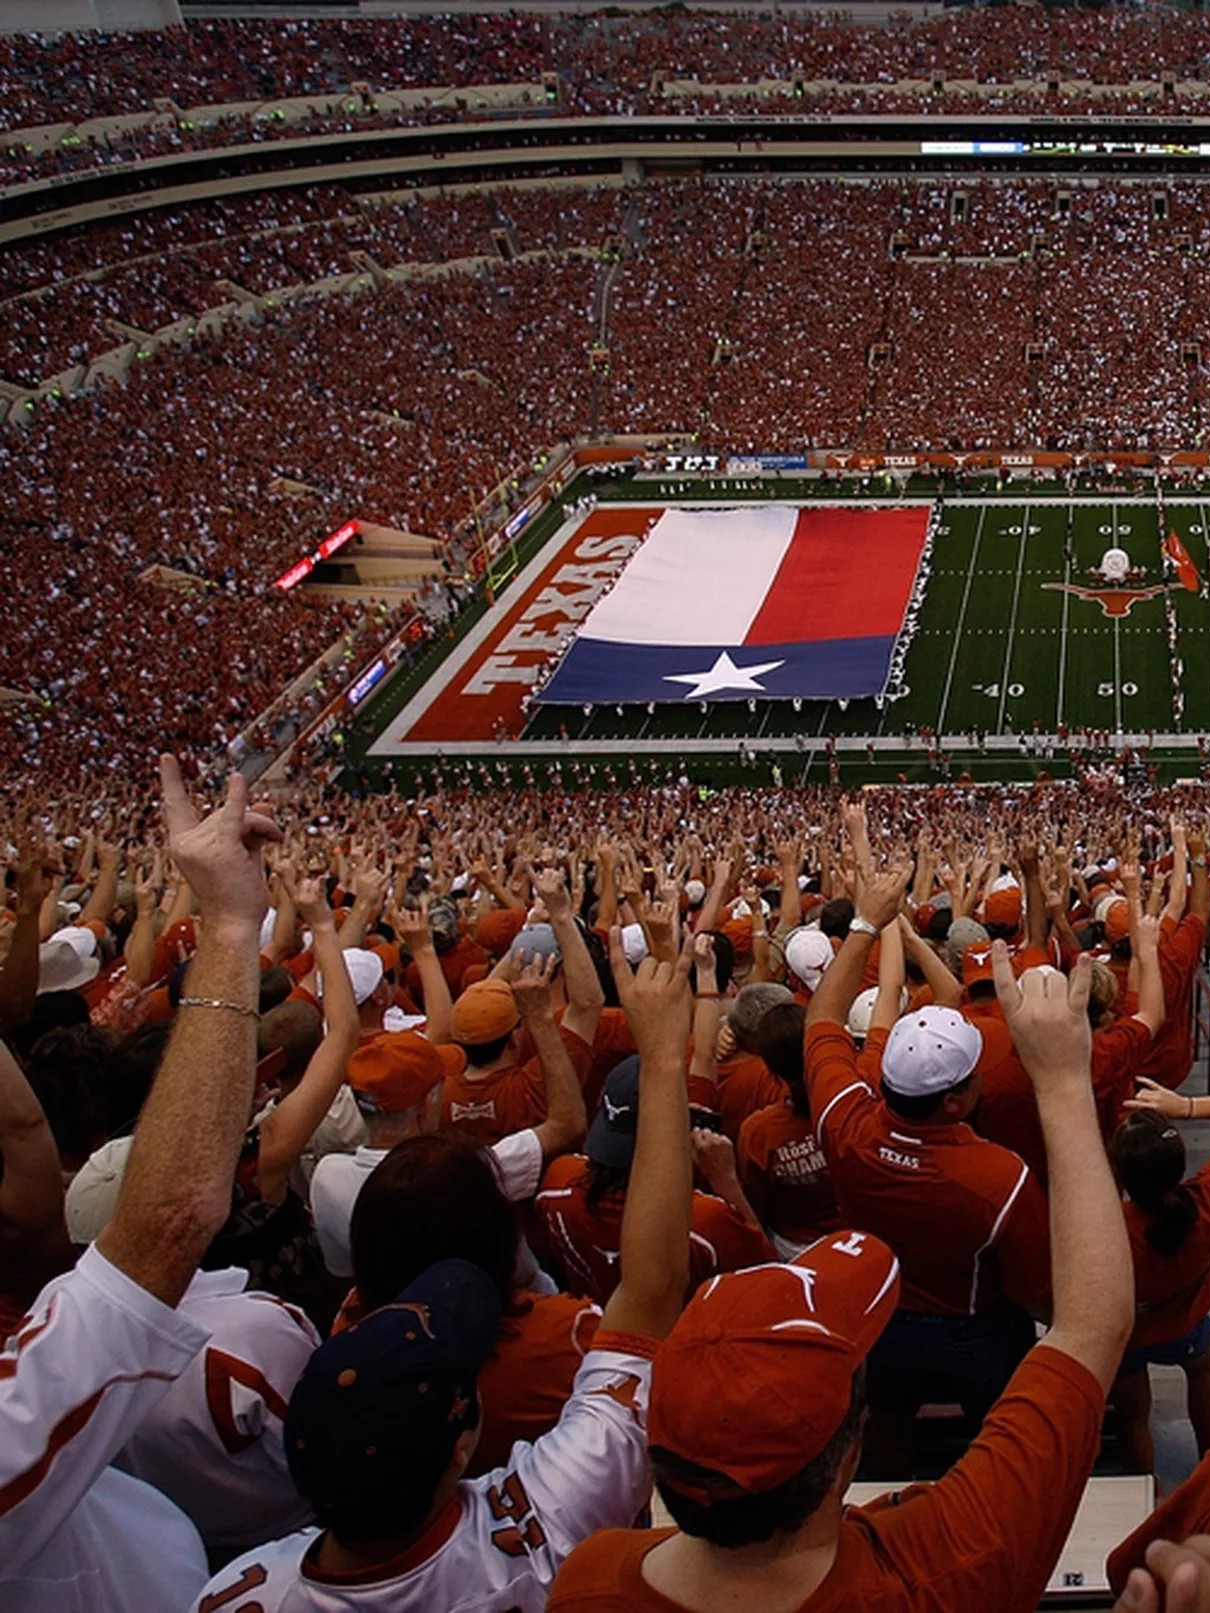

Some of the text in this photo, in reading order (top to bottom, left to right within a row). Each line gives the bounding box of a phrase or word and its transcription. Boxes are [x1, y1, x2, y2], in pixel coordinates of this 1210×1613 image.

[461, 534, 641, 695] TEXAS
[1097, 682, 1138, 697] 50
[878, 1147, 920, 1169] TEXAS
